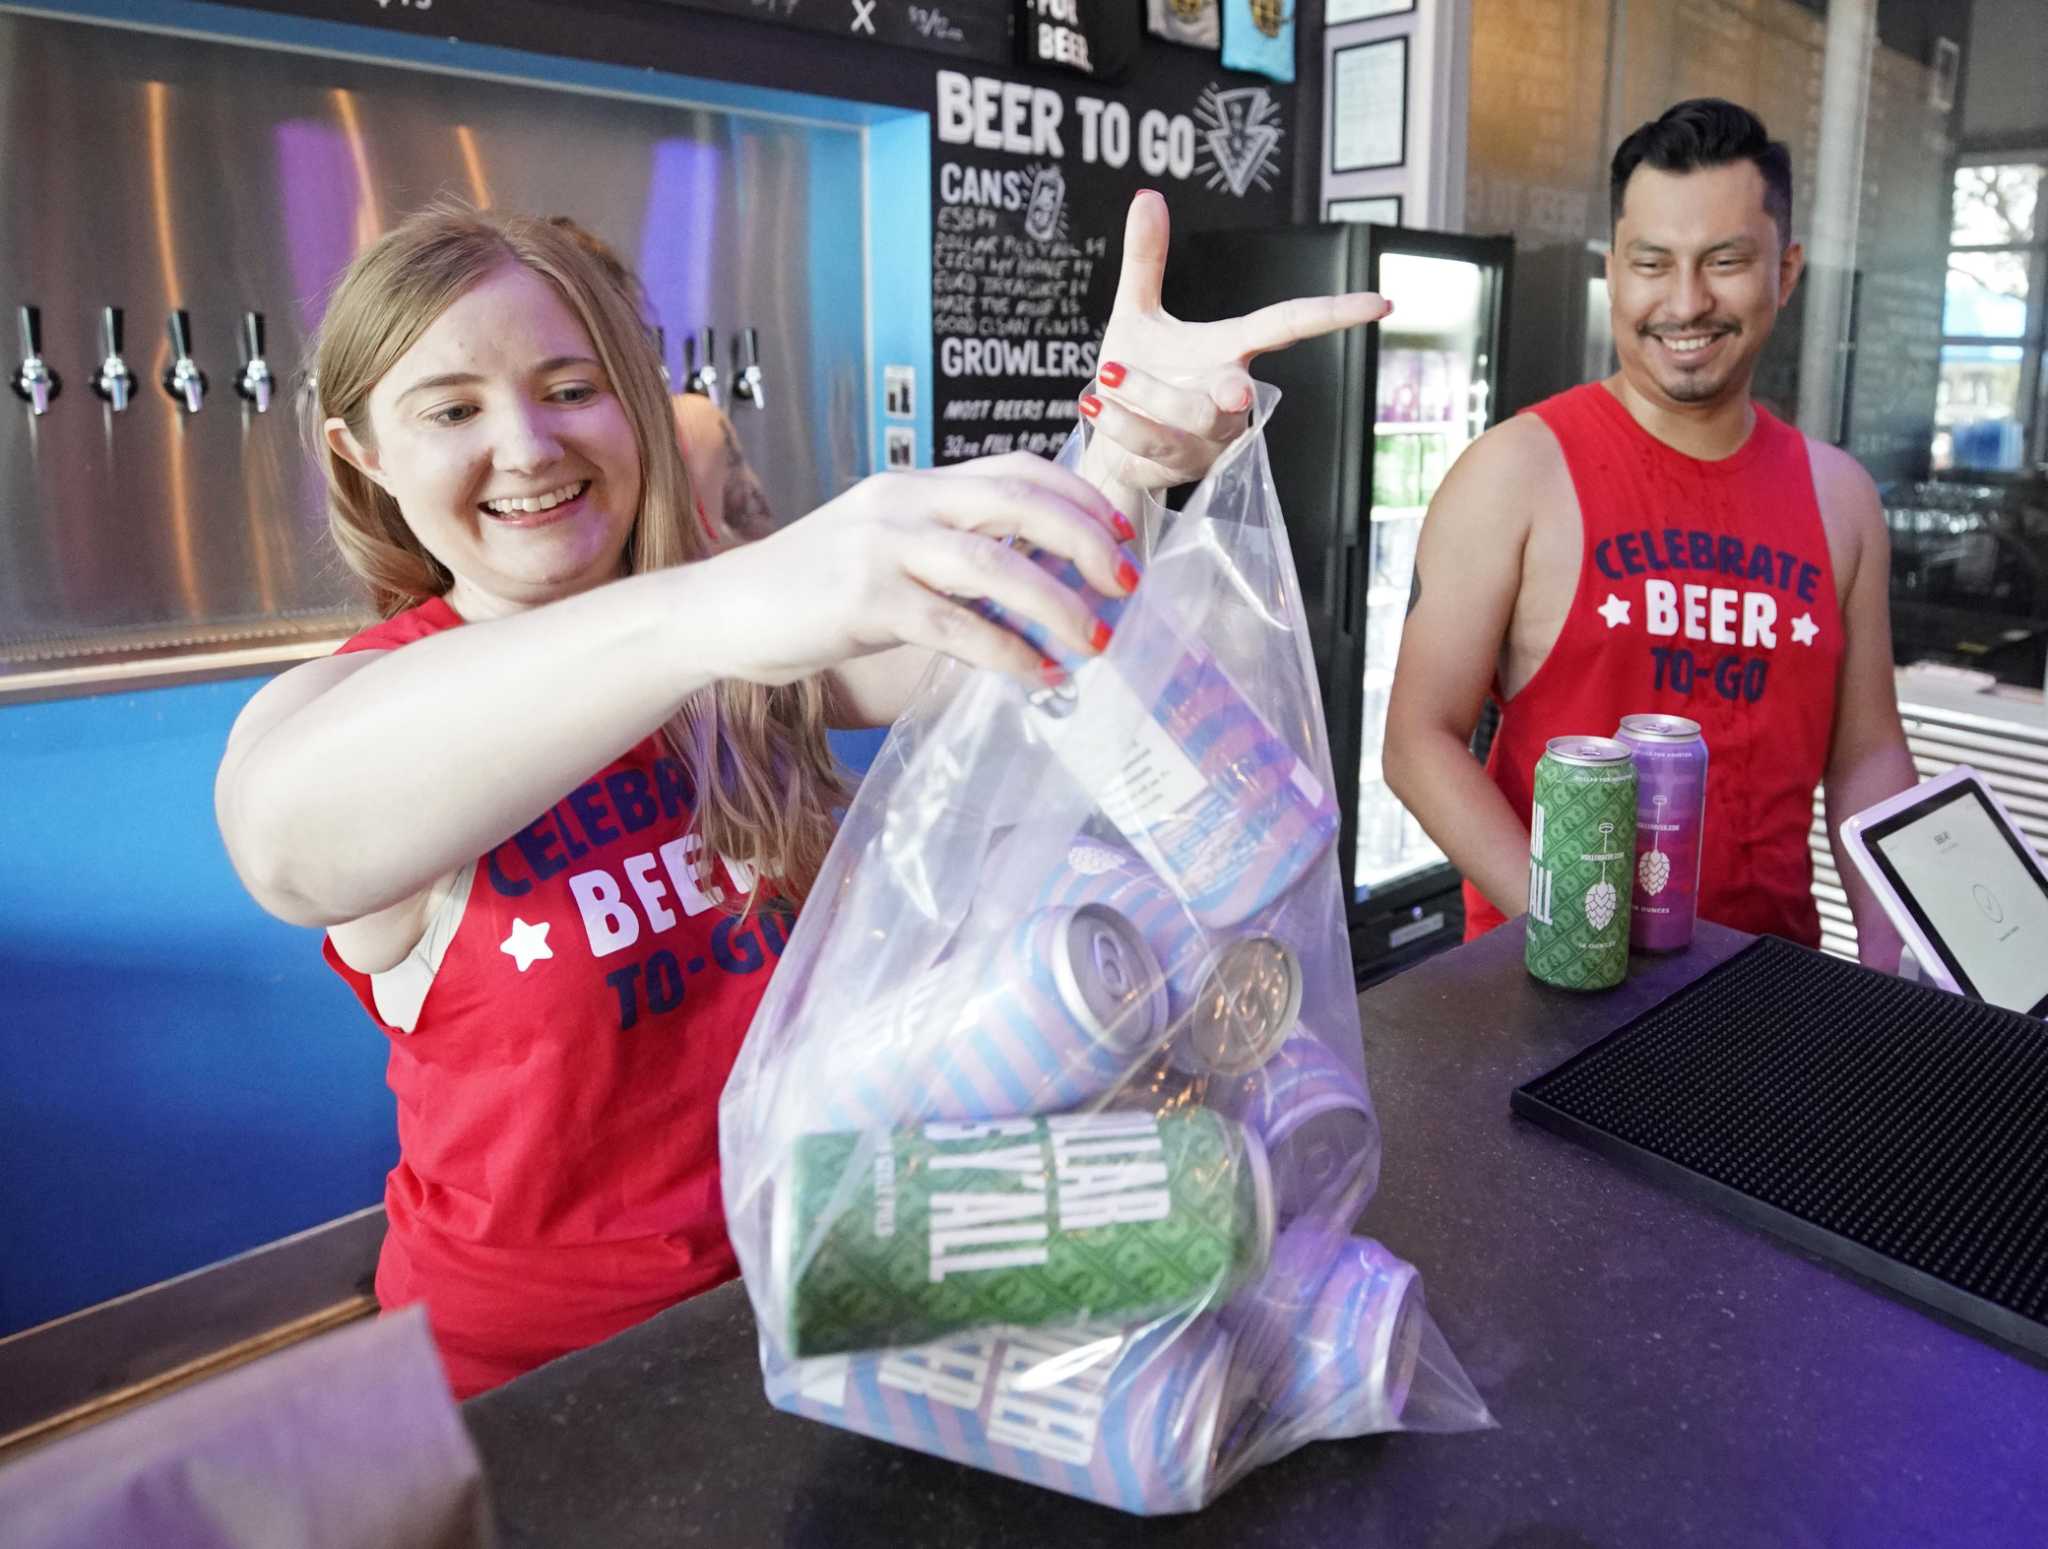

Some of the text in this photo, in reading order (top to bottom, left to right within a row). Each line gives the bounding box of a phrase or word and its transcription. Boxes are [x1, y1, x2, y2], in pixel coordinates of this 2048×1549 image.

[936, 69, 1196, 180] BEER TO GO
[940, 162, 1021, 211] CANS
[940, 337, 1097, 378] GROWLERS
[1595, 529, 1822, 604] CELEBRATE
[1644, 579, 1778, 649] BEER
[1650, 647, 1768, 704] TO-GO
[486, 756, 700, 897] CELEBR
